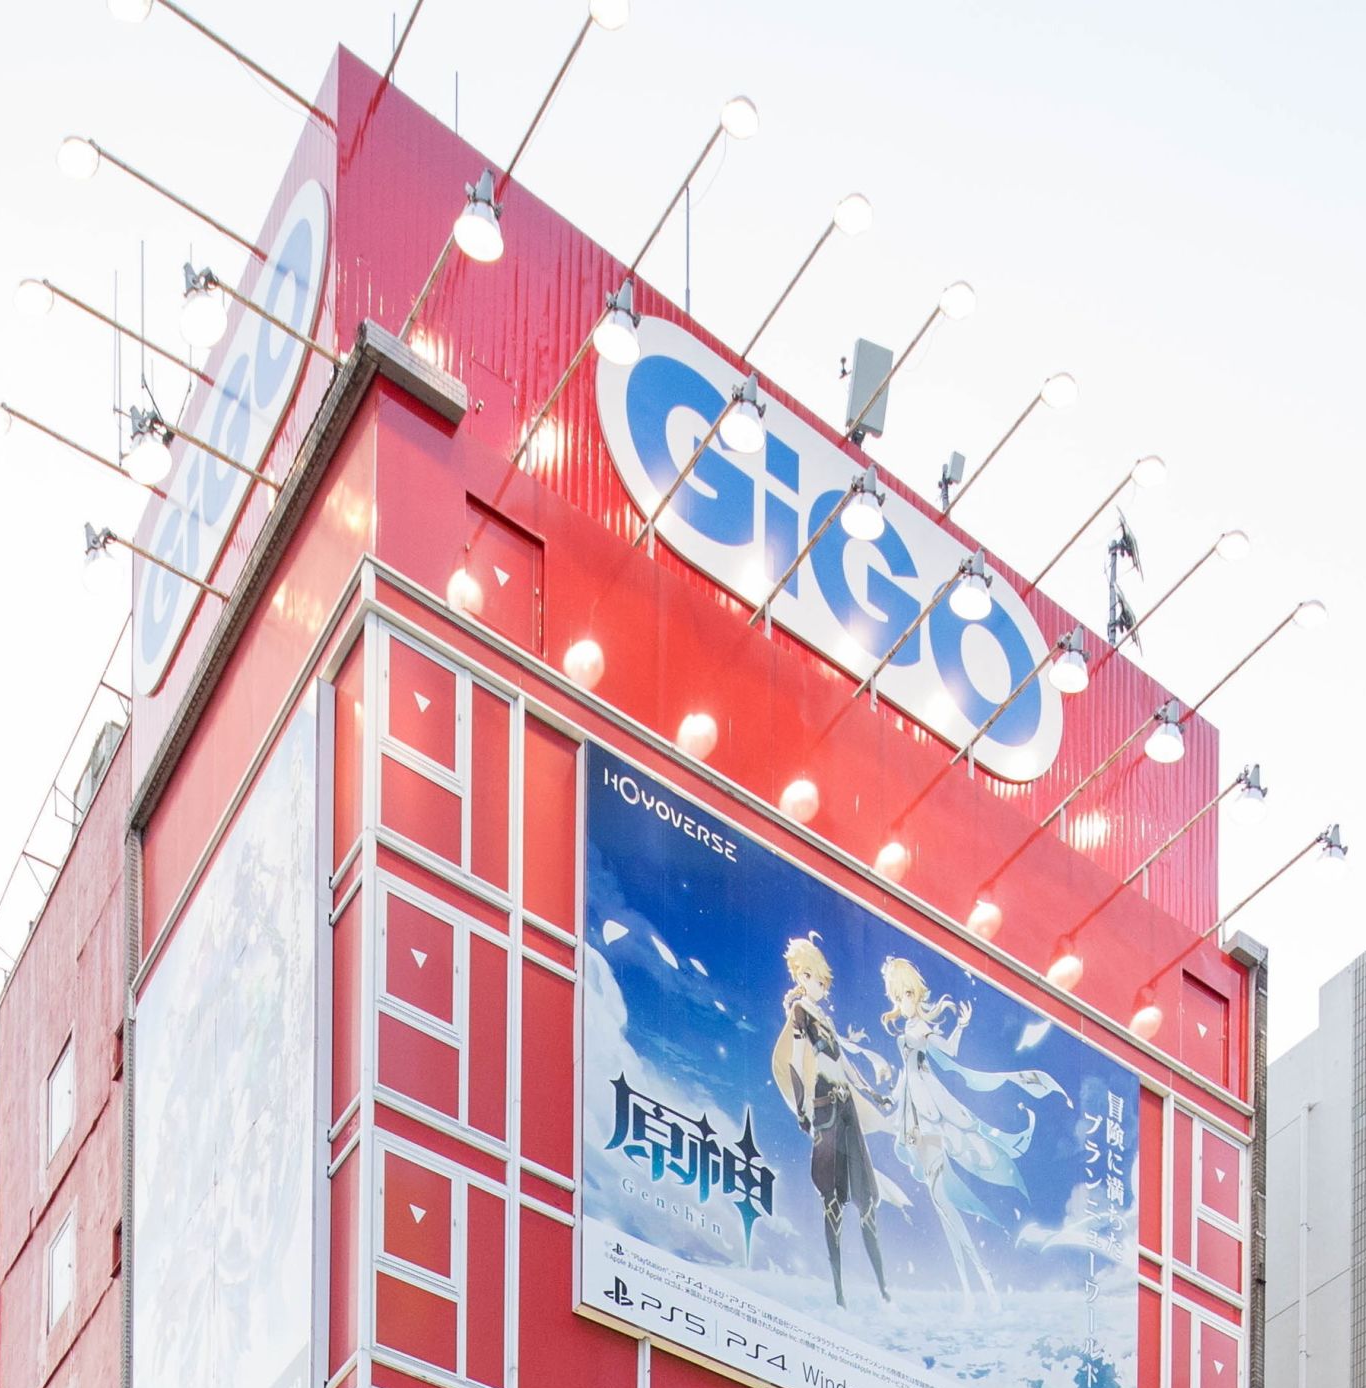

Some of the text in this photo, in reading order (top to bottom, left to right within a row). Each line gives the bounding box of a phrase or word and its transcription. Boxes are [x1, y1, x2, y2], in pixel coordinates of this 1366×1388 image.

[625, 355, 1044, 746] GiGO
[603, 767, 738, 863] HOYOVERSE
[640, 1292, 708, 1337] PS5
[726, 1329, 788, 1372] PS4
